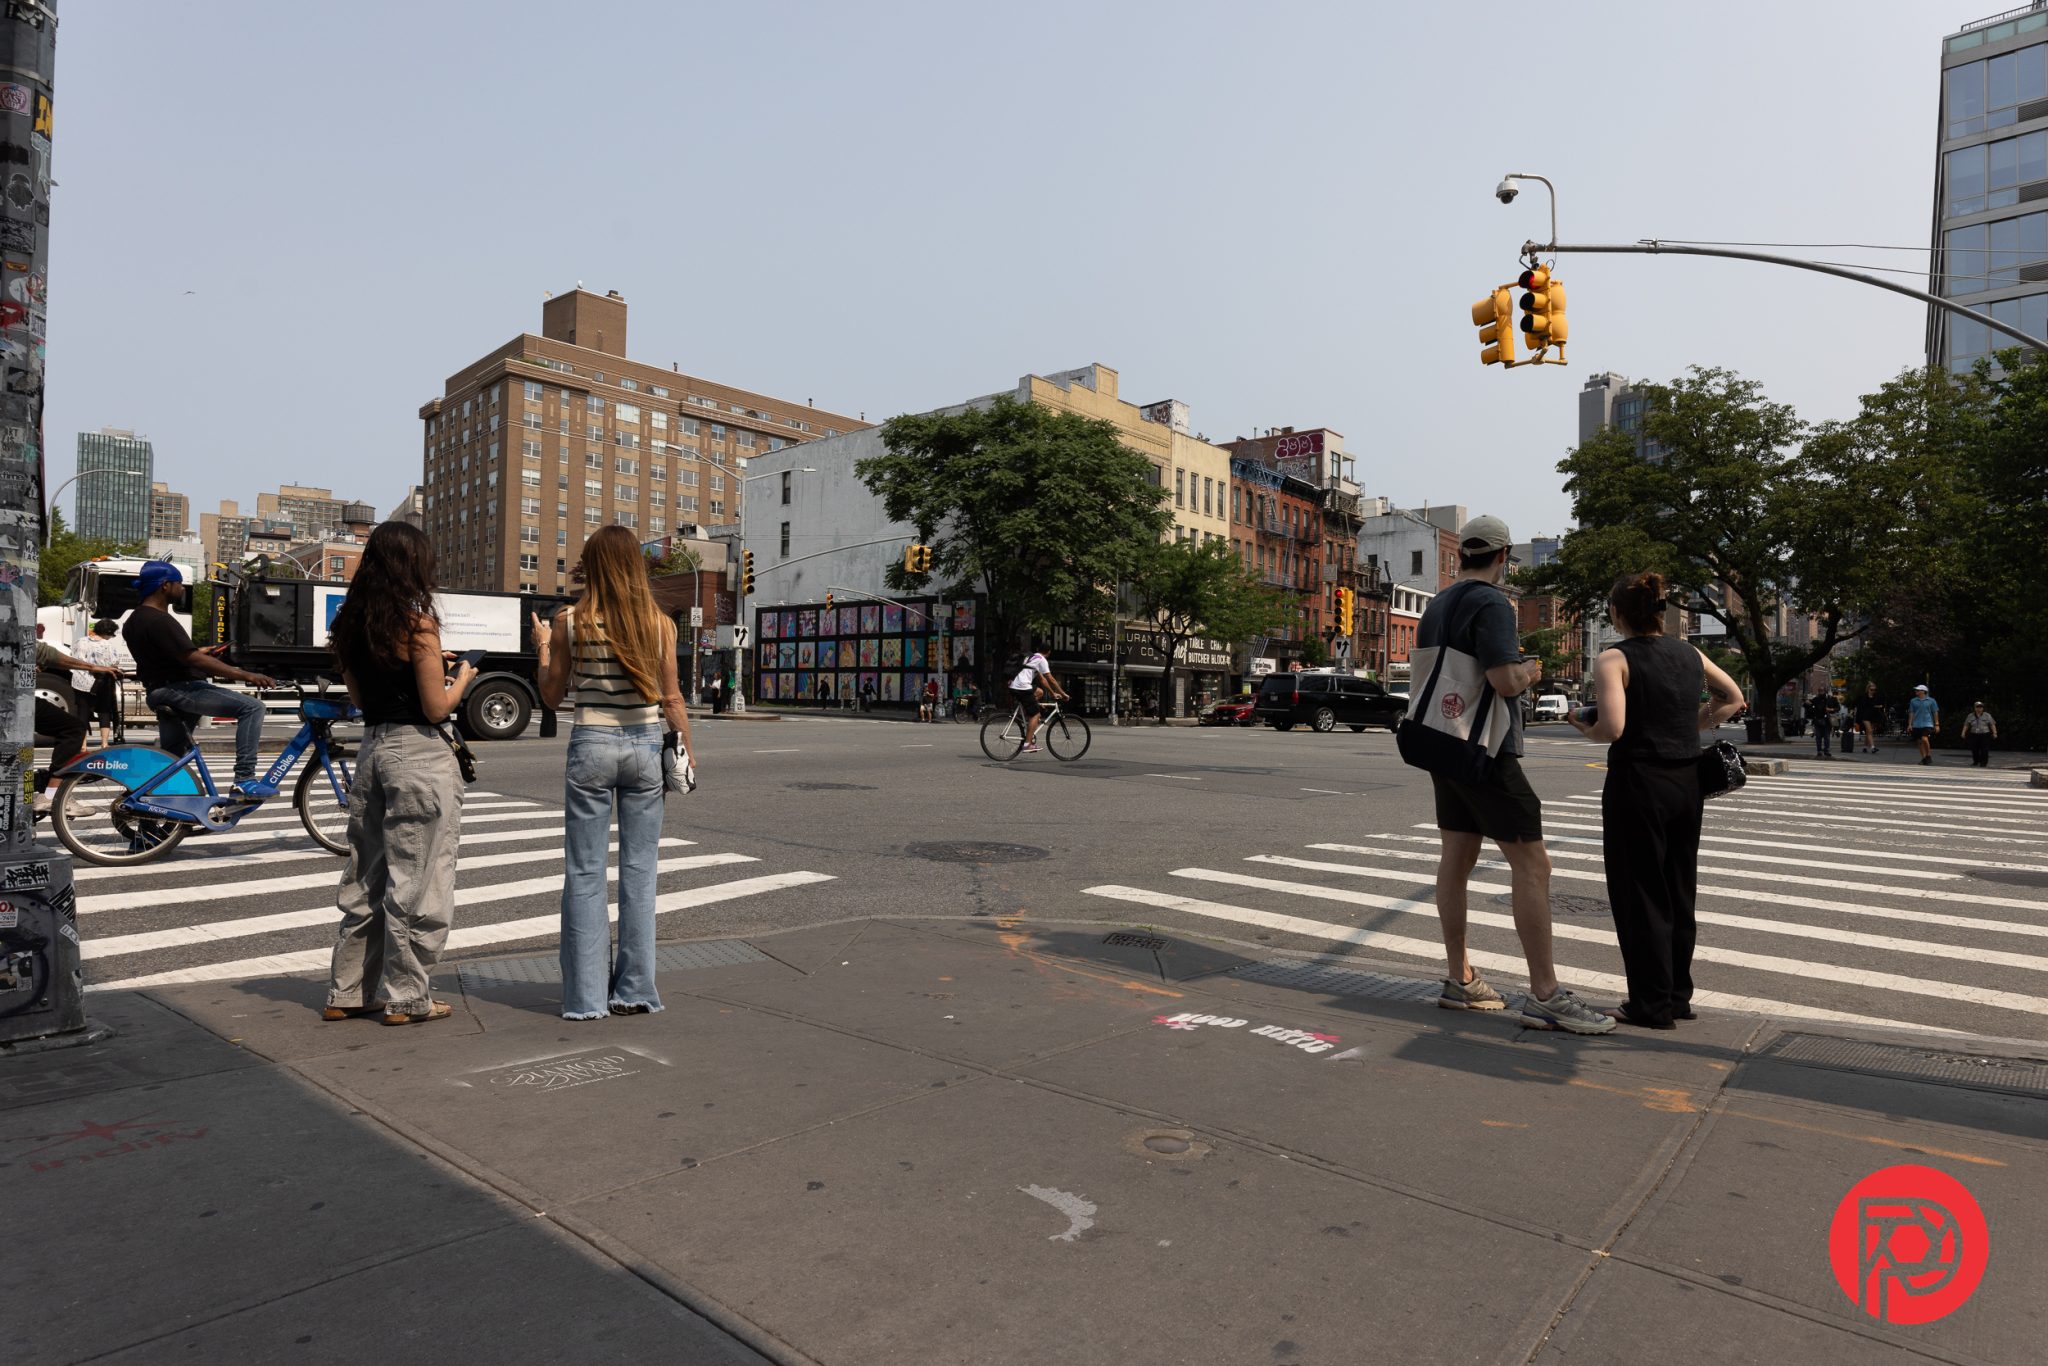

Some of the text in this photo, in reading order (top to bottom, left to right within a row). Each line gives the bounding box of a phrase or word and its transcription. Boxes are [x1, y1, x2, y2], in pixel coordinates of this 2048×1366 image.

[217, 595, 226, 643] AMPLIROLL
[1188, 652, 1210, 664] BUTCHER
[105, 760, 129, 770] bike
[276, 754, 295, 772] bike
